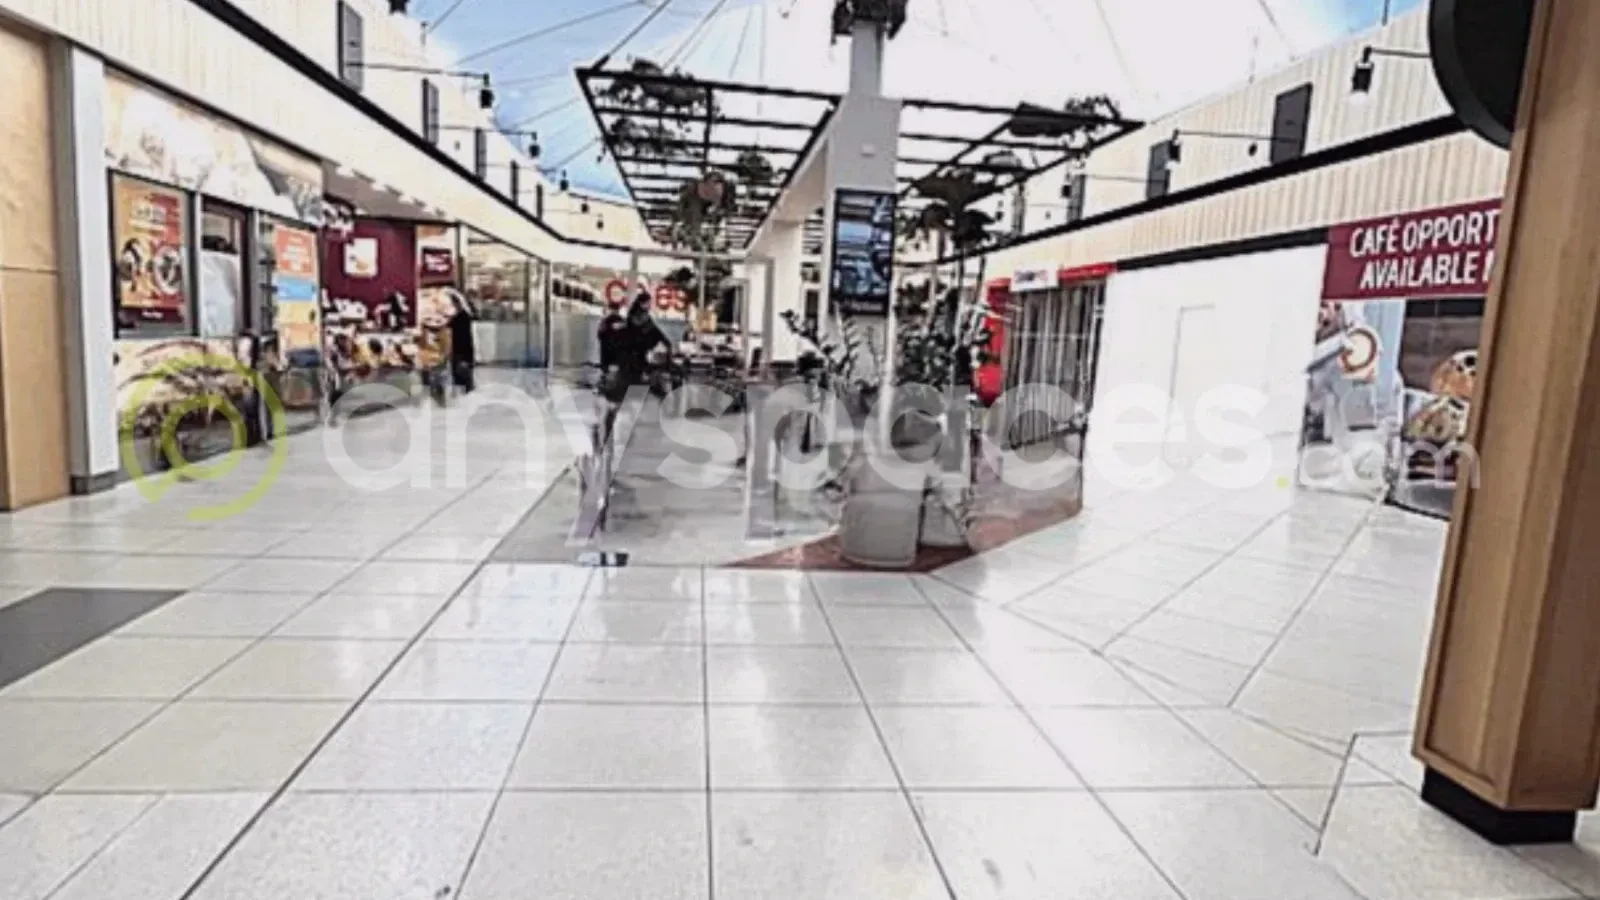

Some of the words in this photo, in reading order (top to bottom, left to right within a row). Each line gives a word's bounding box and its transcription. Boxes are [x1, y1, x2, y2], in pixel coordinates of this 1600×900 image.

[1350, 215, 1399, 258] CAFÉ
[1359, 250, 1479, 290] AVAILABLE
[605, 279, 689, 312] Ces
